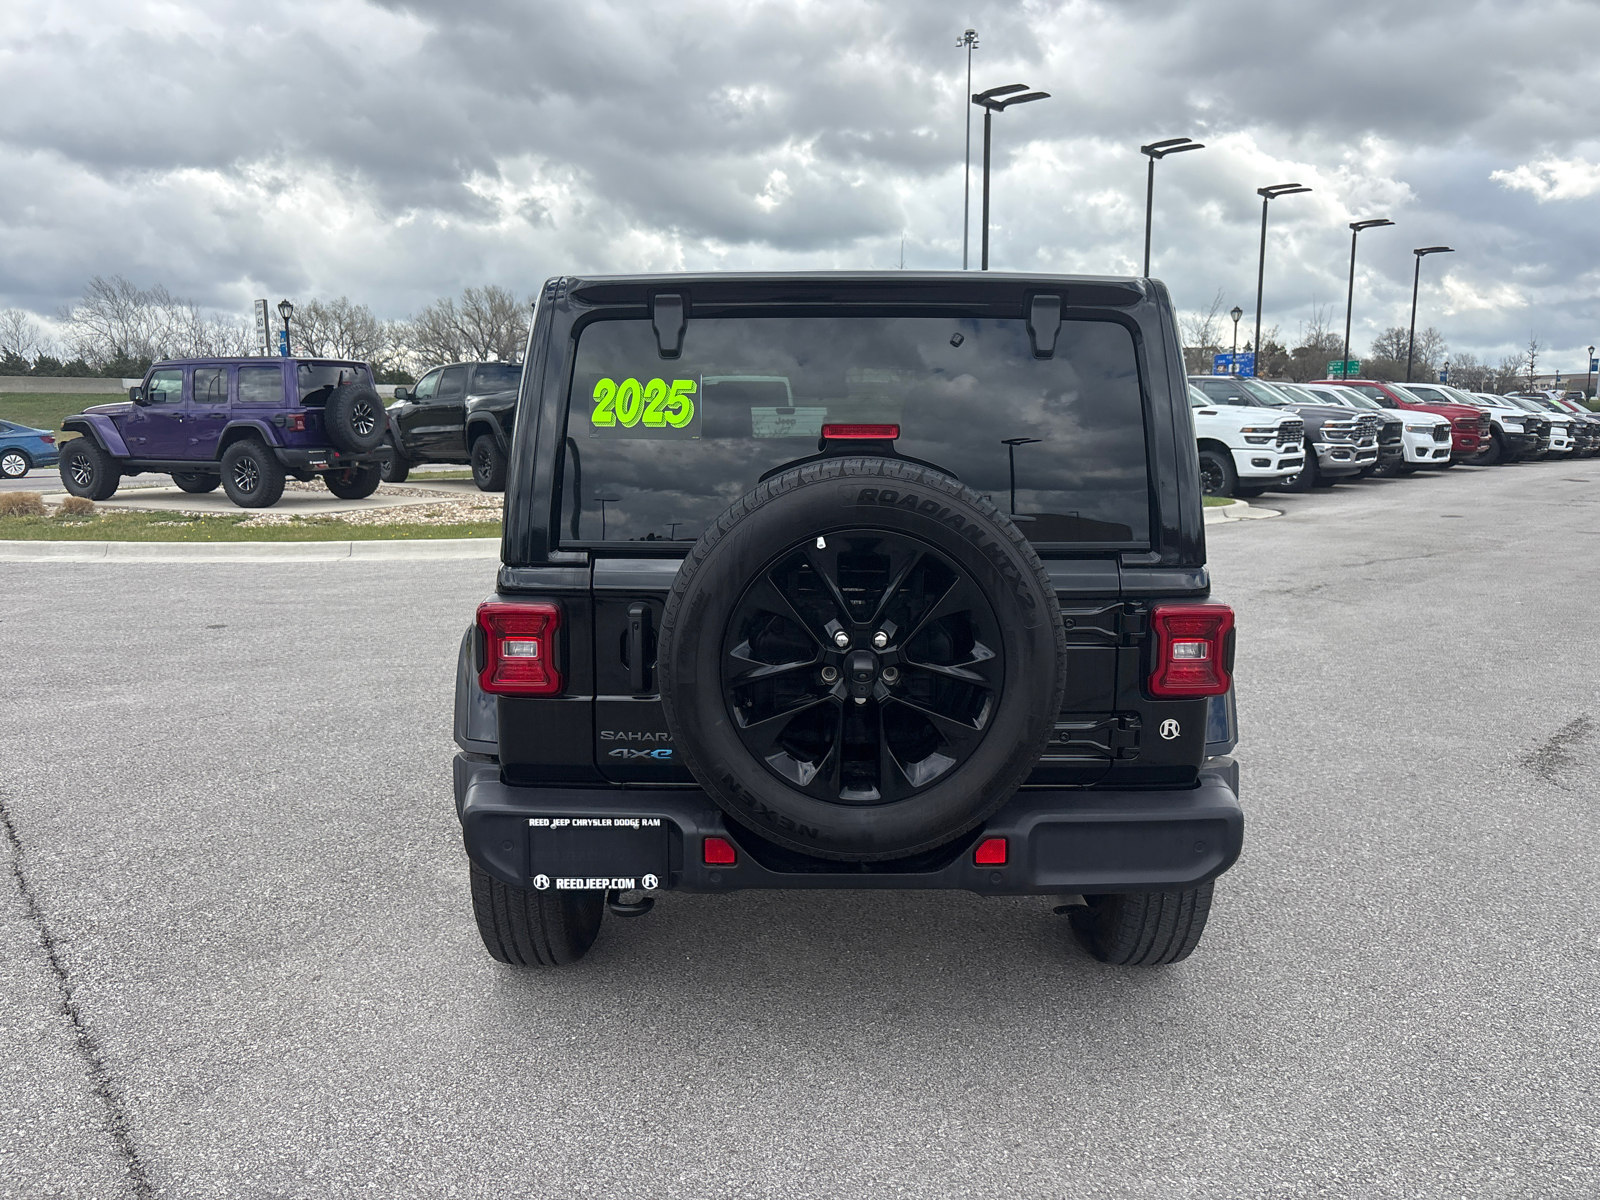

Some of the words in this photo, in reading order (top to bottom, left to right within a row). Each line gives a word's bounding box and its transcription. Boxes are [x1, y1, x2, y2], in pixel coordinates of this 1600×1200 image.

[591, 377, 697, 428] 2025
[775, 417, 796, 427] Jeep
[857, 488, 986, 544] ROADIAN
[721, 772, 819, 839] NEXEN
[529, 818, 549, 827] REED
[551, 818, 570, 828] JEEP
[572, 818, 612, 827] CHRYSLER
[614, 818, 640, 827] DODGE
[641, 818, 661, 827] RAM
[556, 878, 635, 890] REEDJEEP.COM
